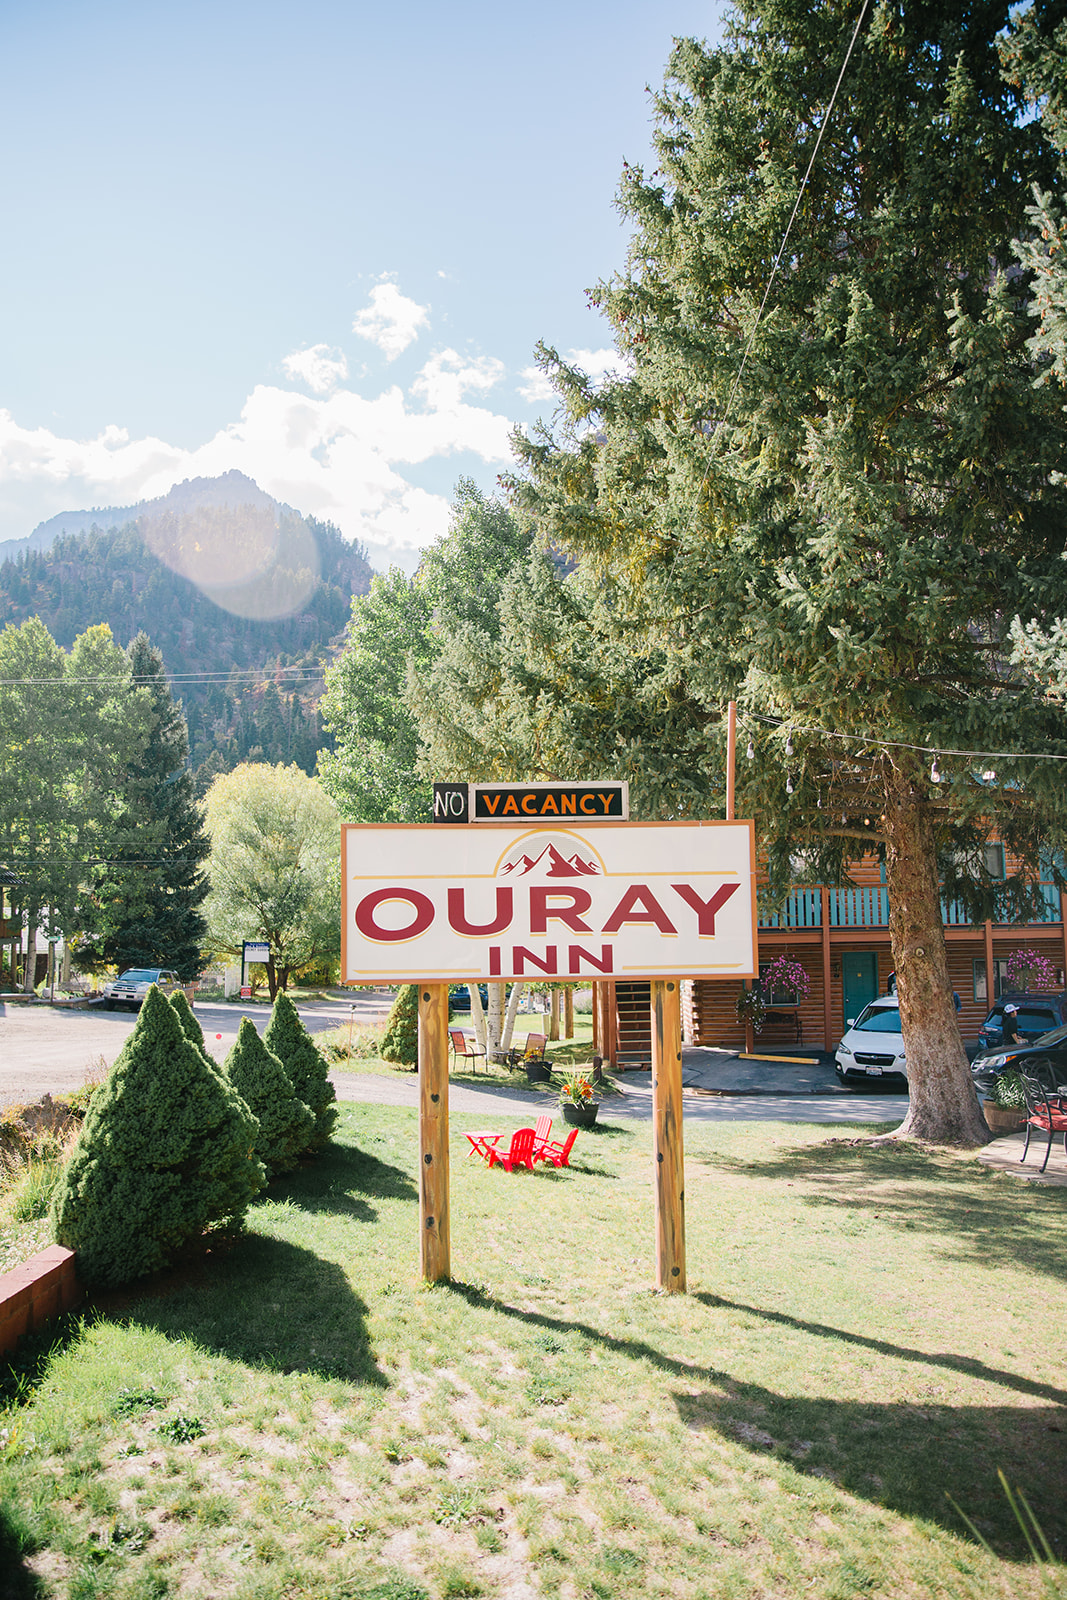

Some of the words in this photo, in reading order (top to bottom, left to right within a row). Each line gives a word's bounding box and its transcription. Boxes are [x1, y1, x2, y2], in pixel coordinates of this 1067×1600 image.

[434, 790, 465, 817] NO
[482, 793, 615, 815] VACANCY
[354, 882, 742, 944] OURAY
[489, 944, 614, 976] INN
